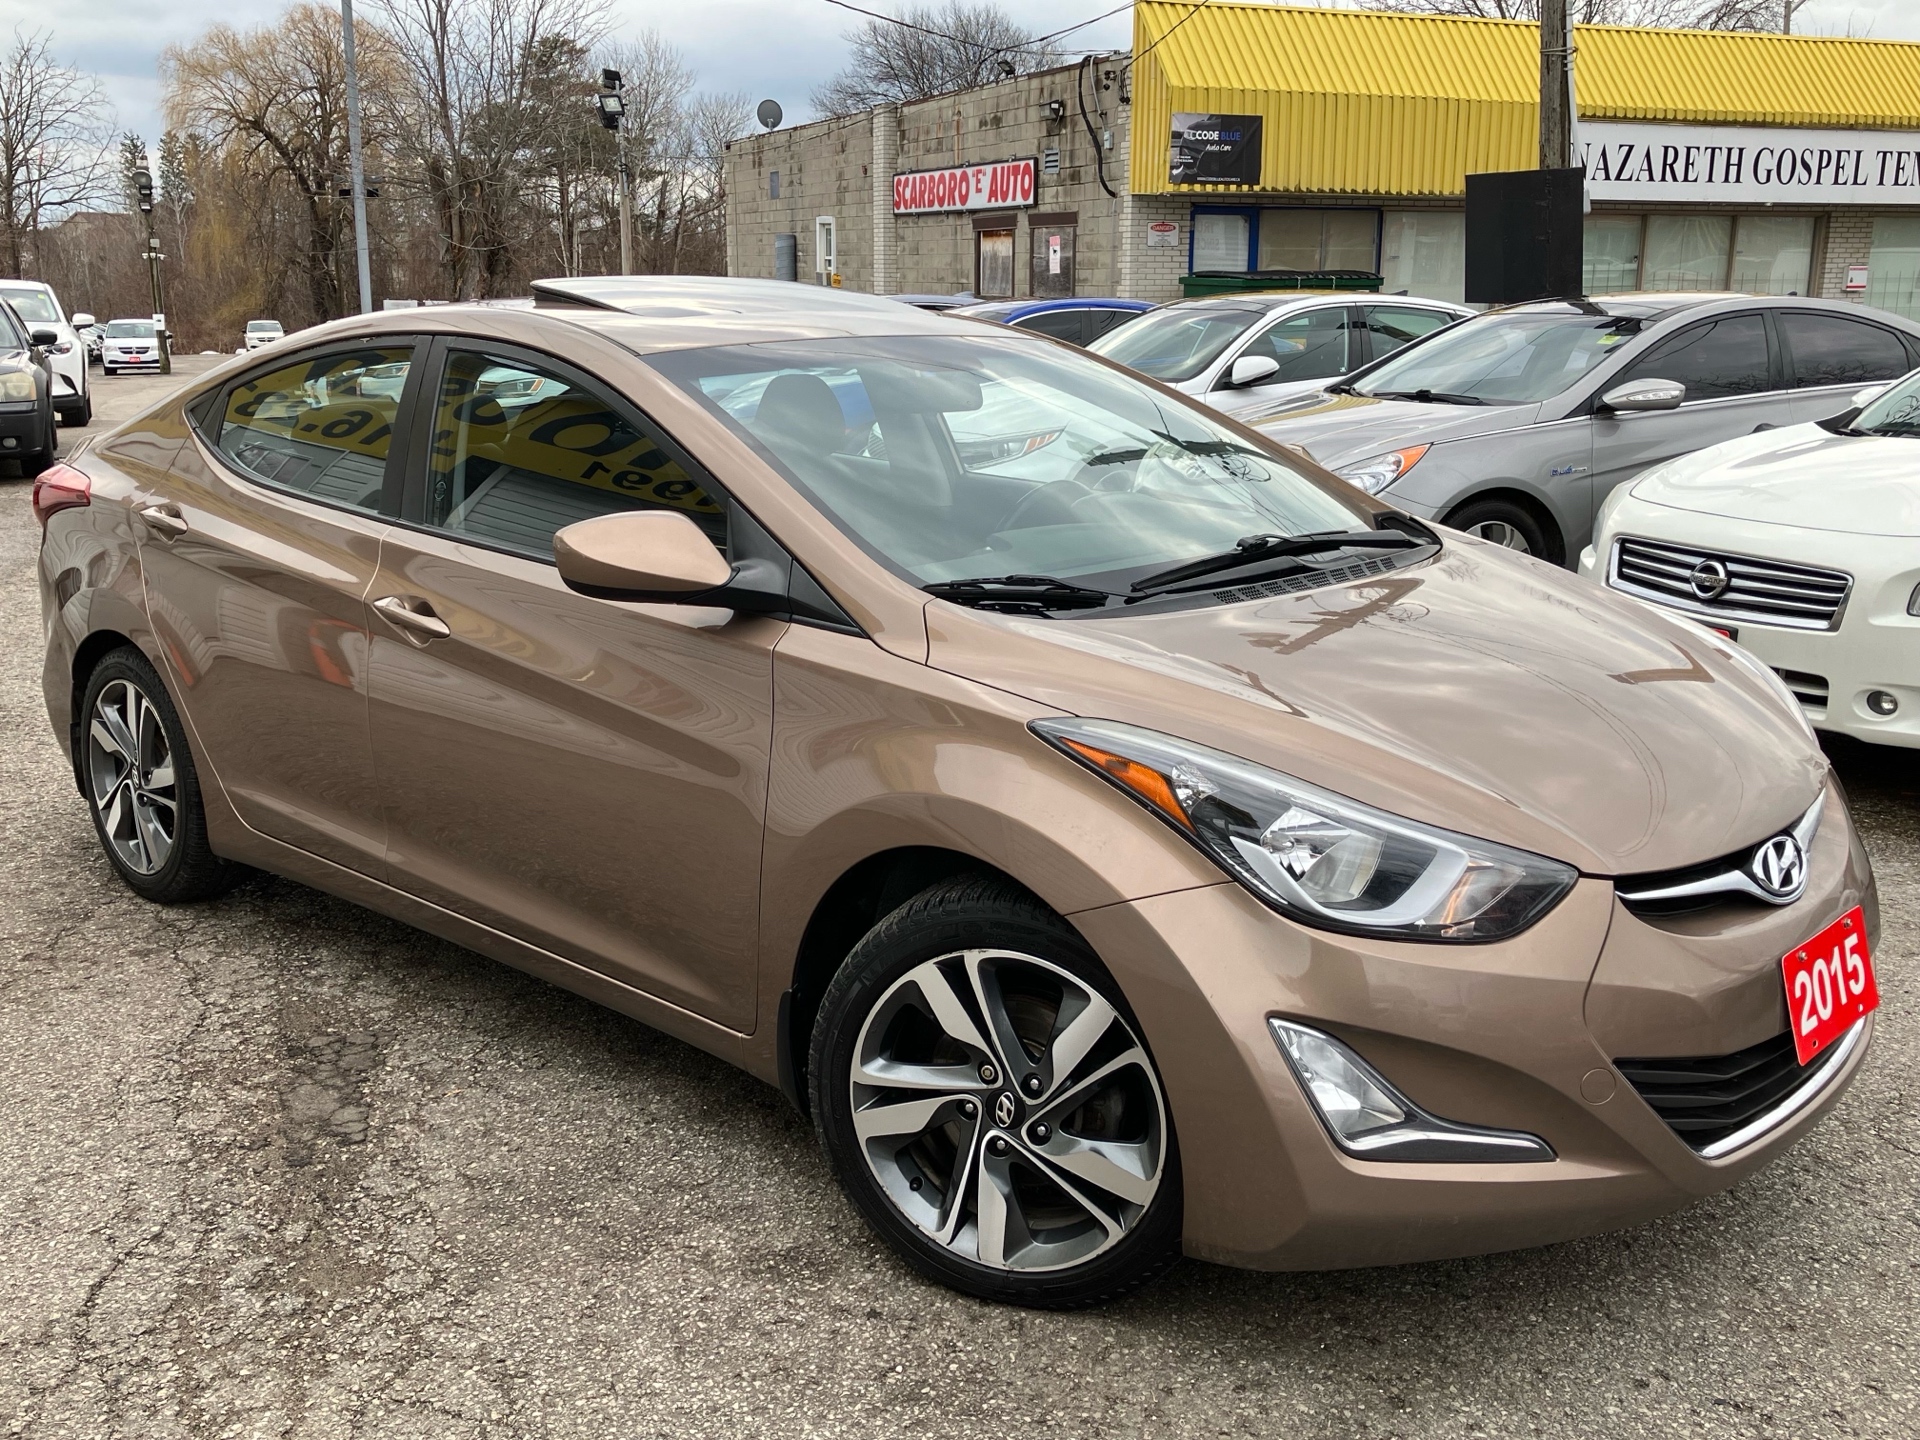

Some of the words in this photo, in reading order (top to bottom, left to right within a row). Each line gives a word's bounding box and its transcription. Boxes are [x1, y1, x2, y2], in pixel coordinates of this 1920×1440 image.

[1196, 131, 1219, 140] CODE
[1221, 131, 1241, 140] BLUE
[894, 170, 970, 210] SCARBORO
[987, 162, 1033, 203] AUTO
[1753, 147, 1869, 185] GOSPEL
[1794, 933, 1865, 1037] 2015
